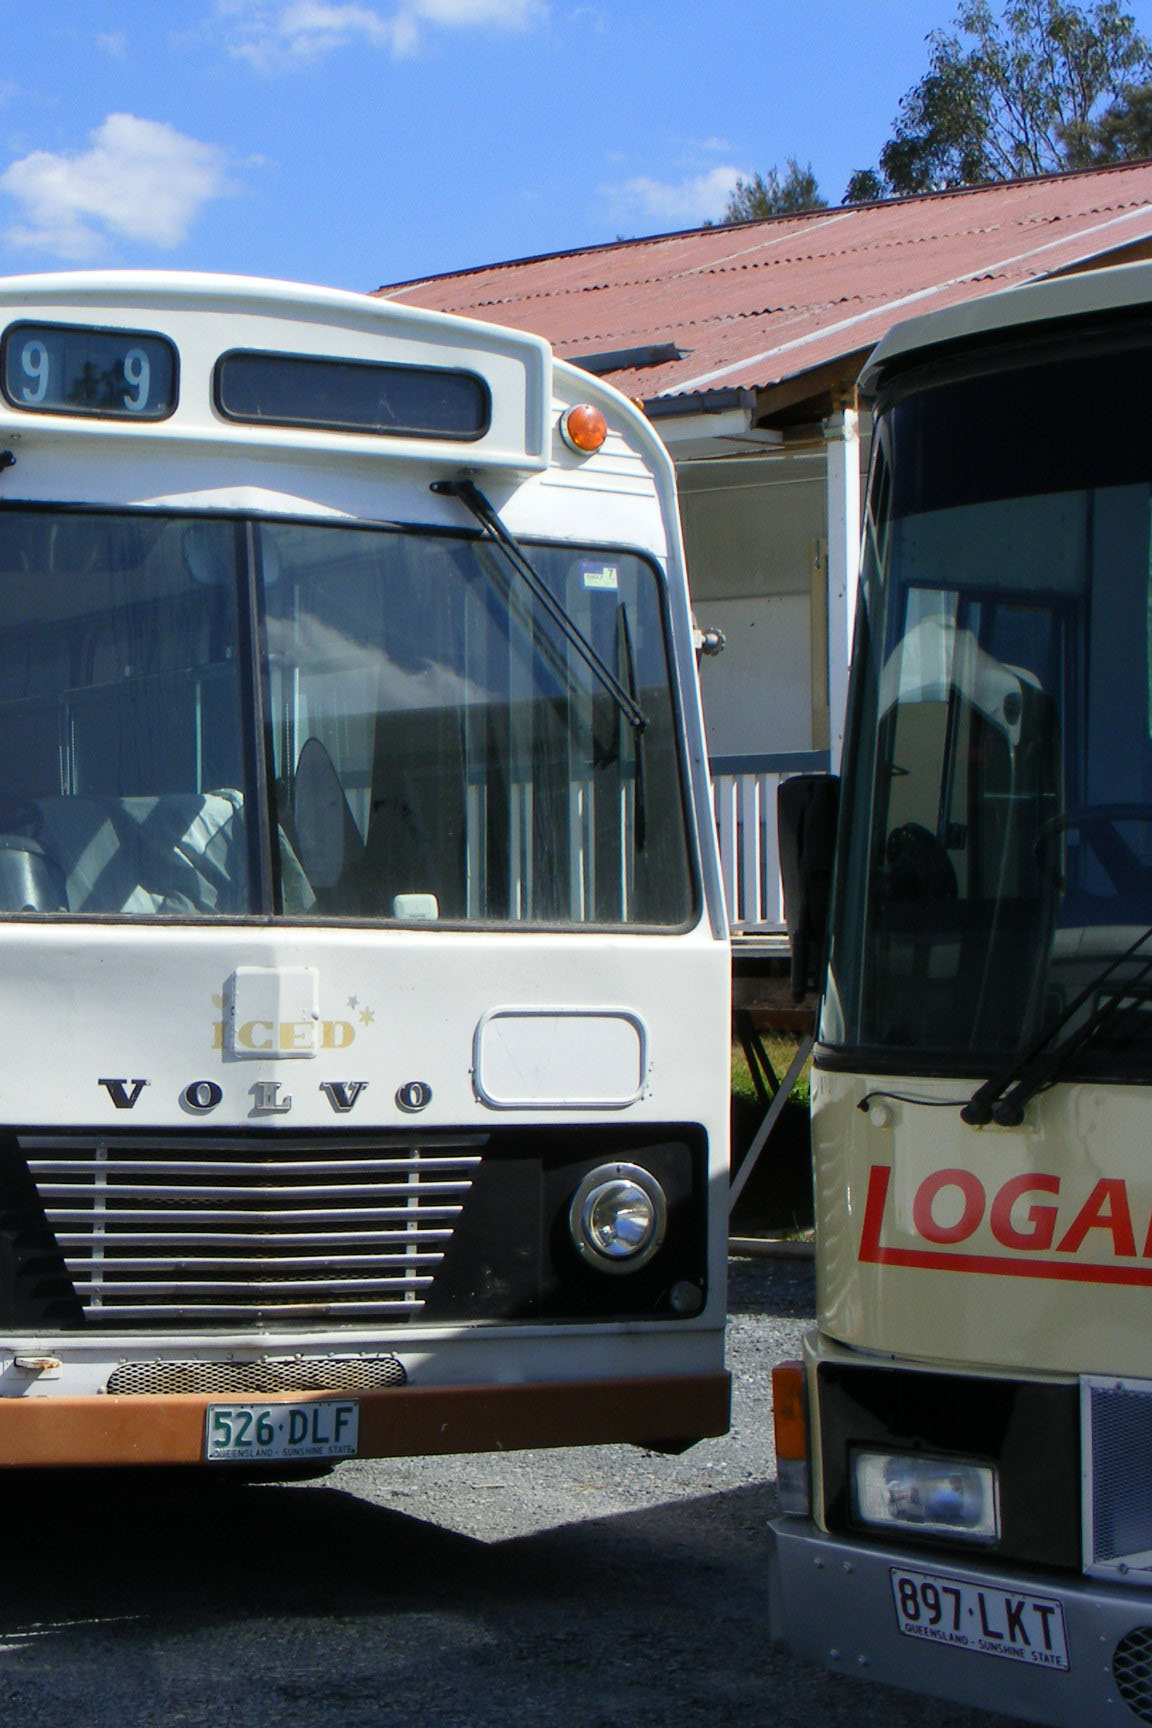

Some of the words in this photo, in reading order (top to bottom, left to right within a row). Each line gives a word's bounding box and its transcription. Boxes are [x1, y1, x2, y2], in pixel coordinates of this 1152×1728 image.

[21, 341, 48, 402] 9
[123, 349, 150, 411] 9
[97, 1078, 433, 1112] VOLVO
[858, 1165, 1152, 1262] LOGA
[282, 1447, 323, 1456] SUNSHINE
[328, 1446, 353, 1454] STATE
[904, 1622, 969, 1646] QUEENSLAND
[978, 1638, 1025, 1658] SUNSHINE
[1031, 1650, 1063, 1666] STATE
